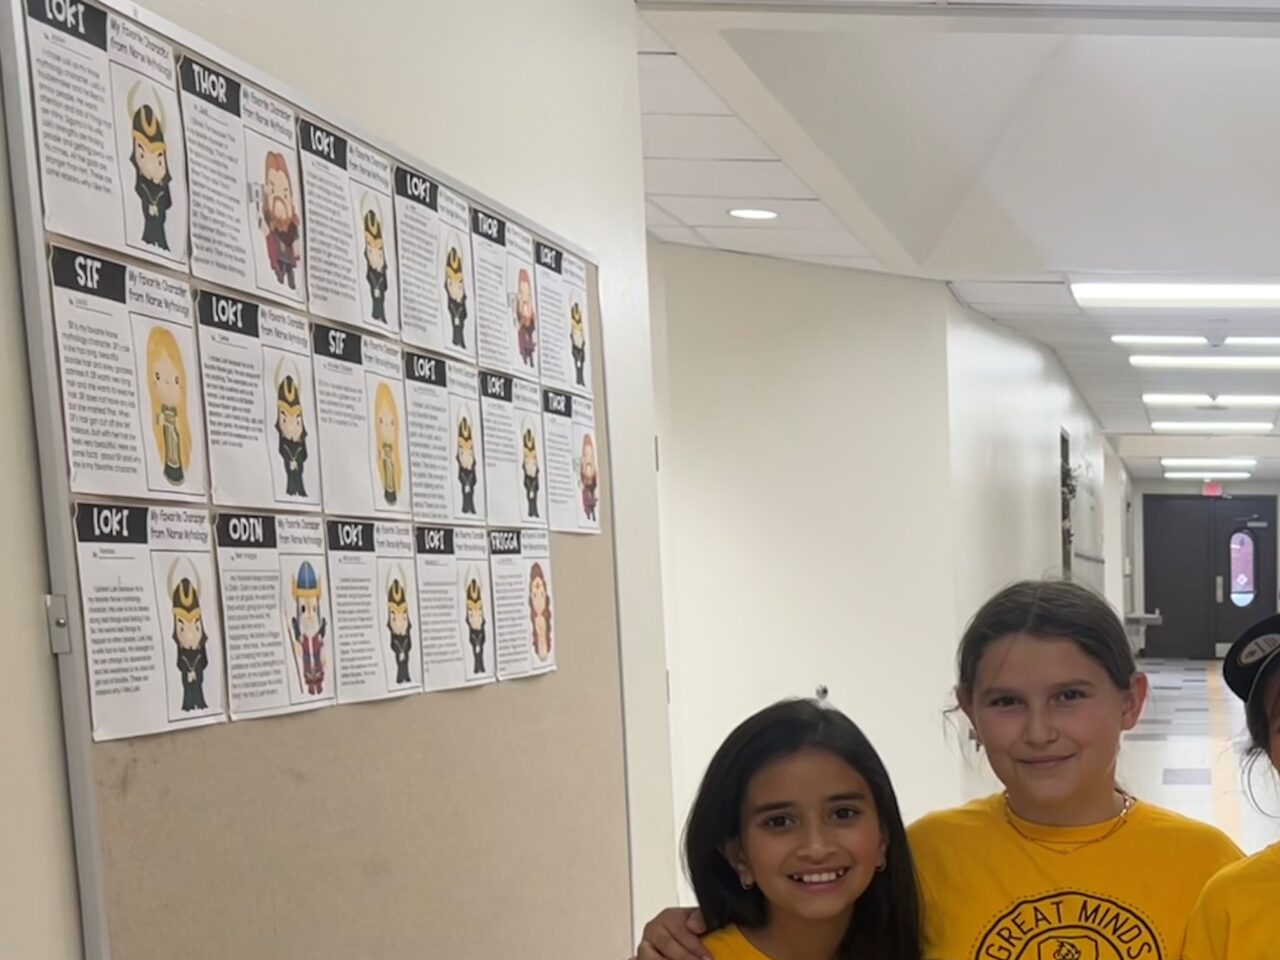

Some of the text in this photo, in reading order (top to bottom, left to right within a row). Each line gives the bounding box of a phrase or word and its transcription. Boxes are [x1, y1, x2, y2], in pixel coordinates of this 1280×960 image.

[45, 0, 85, 34] LOKI
[192, 63, 227, 103] THOR
[311, 126, 335, 160] LOKI
[407, 174, 430, 203] LOKI
[75, 256, 102, 289] SIF
[212, 296, 243, 328] LOKI
[328, 330, 347, 355] SIF
[413, 356, 436, 380] LOKI
[93, 507, 129, 536] LOKI
[229, 517, 263, 542] ODIN
[338, 523, 363, 546] LOKI
[1078, 899, 1153, 960] MINDS
